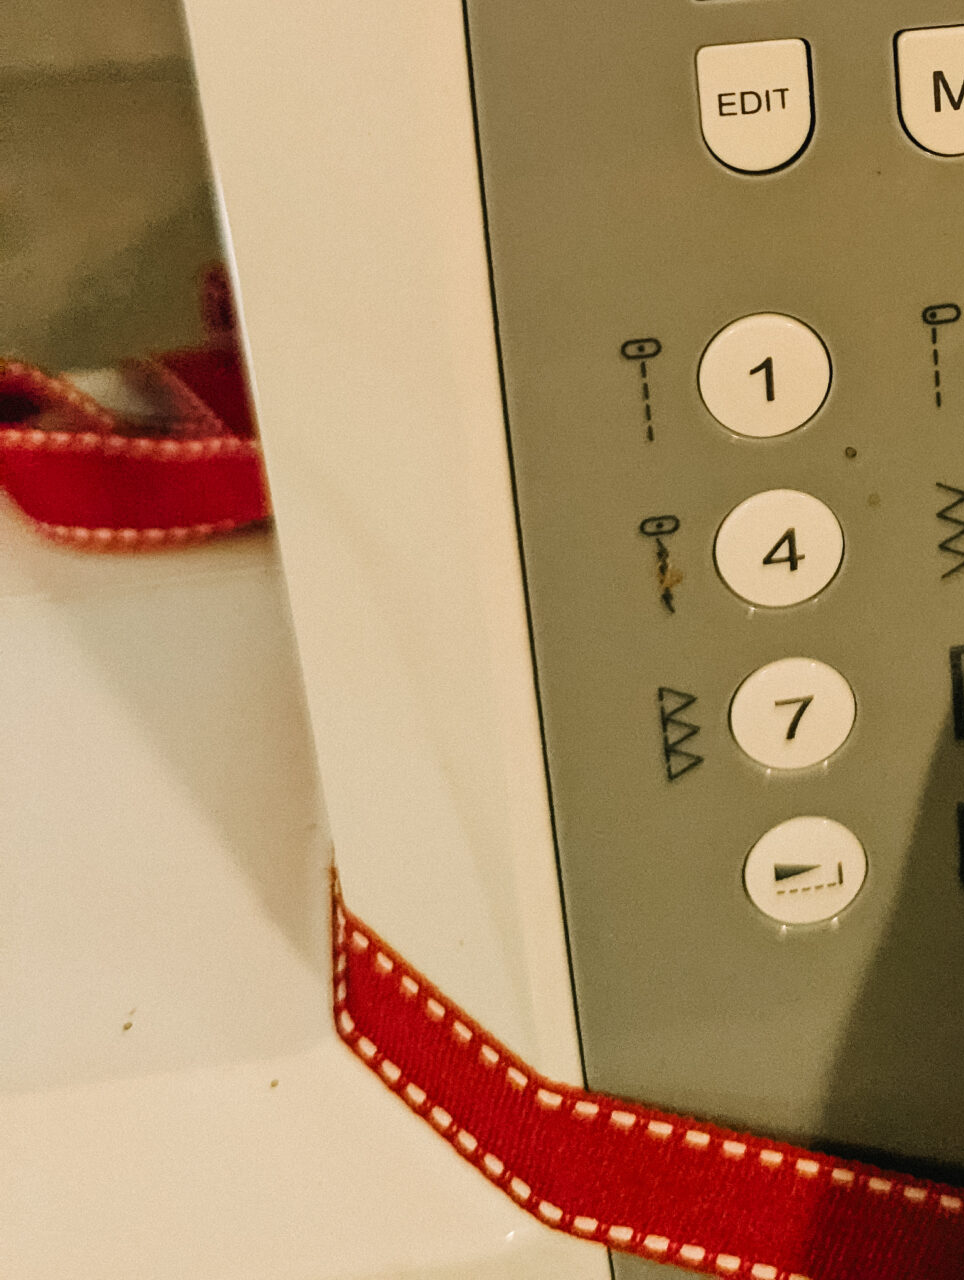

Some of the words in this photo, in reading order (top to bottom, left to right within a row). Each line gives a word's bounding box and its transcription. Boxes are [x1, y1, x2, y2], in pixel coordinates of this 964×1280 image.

[717, 87, 790, 117] EDIT
[749, 356, 775, 403] 1
[762, 528, 806, 573] 4
[774, 696, 814, 741] 7
